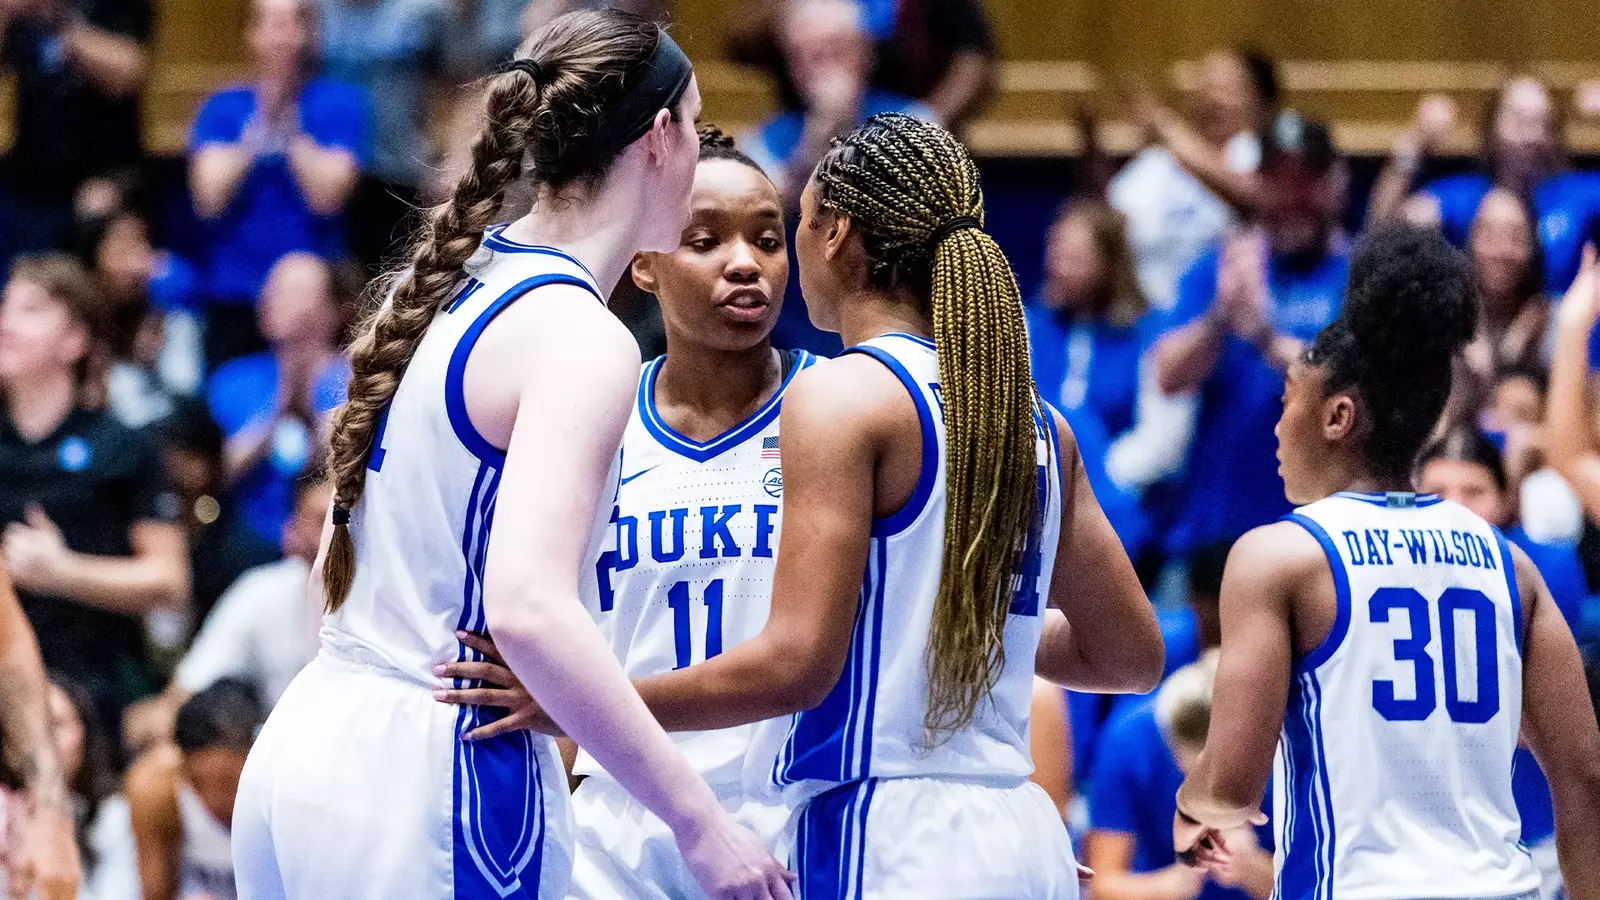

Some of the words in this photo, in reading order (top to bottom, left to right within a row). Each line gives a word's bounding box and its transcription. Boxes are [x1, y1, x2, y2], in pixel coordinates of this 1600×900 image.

[1342, 527, 1498, 571] DAY-WILSON
[667, 579, 724, 671] 11
[1368, 587, 1500, 724] 30
